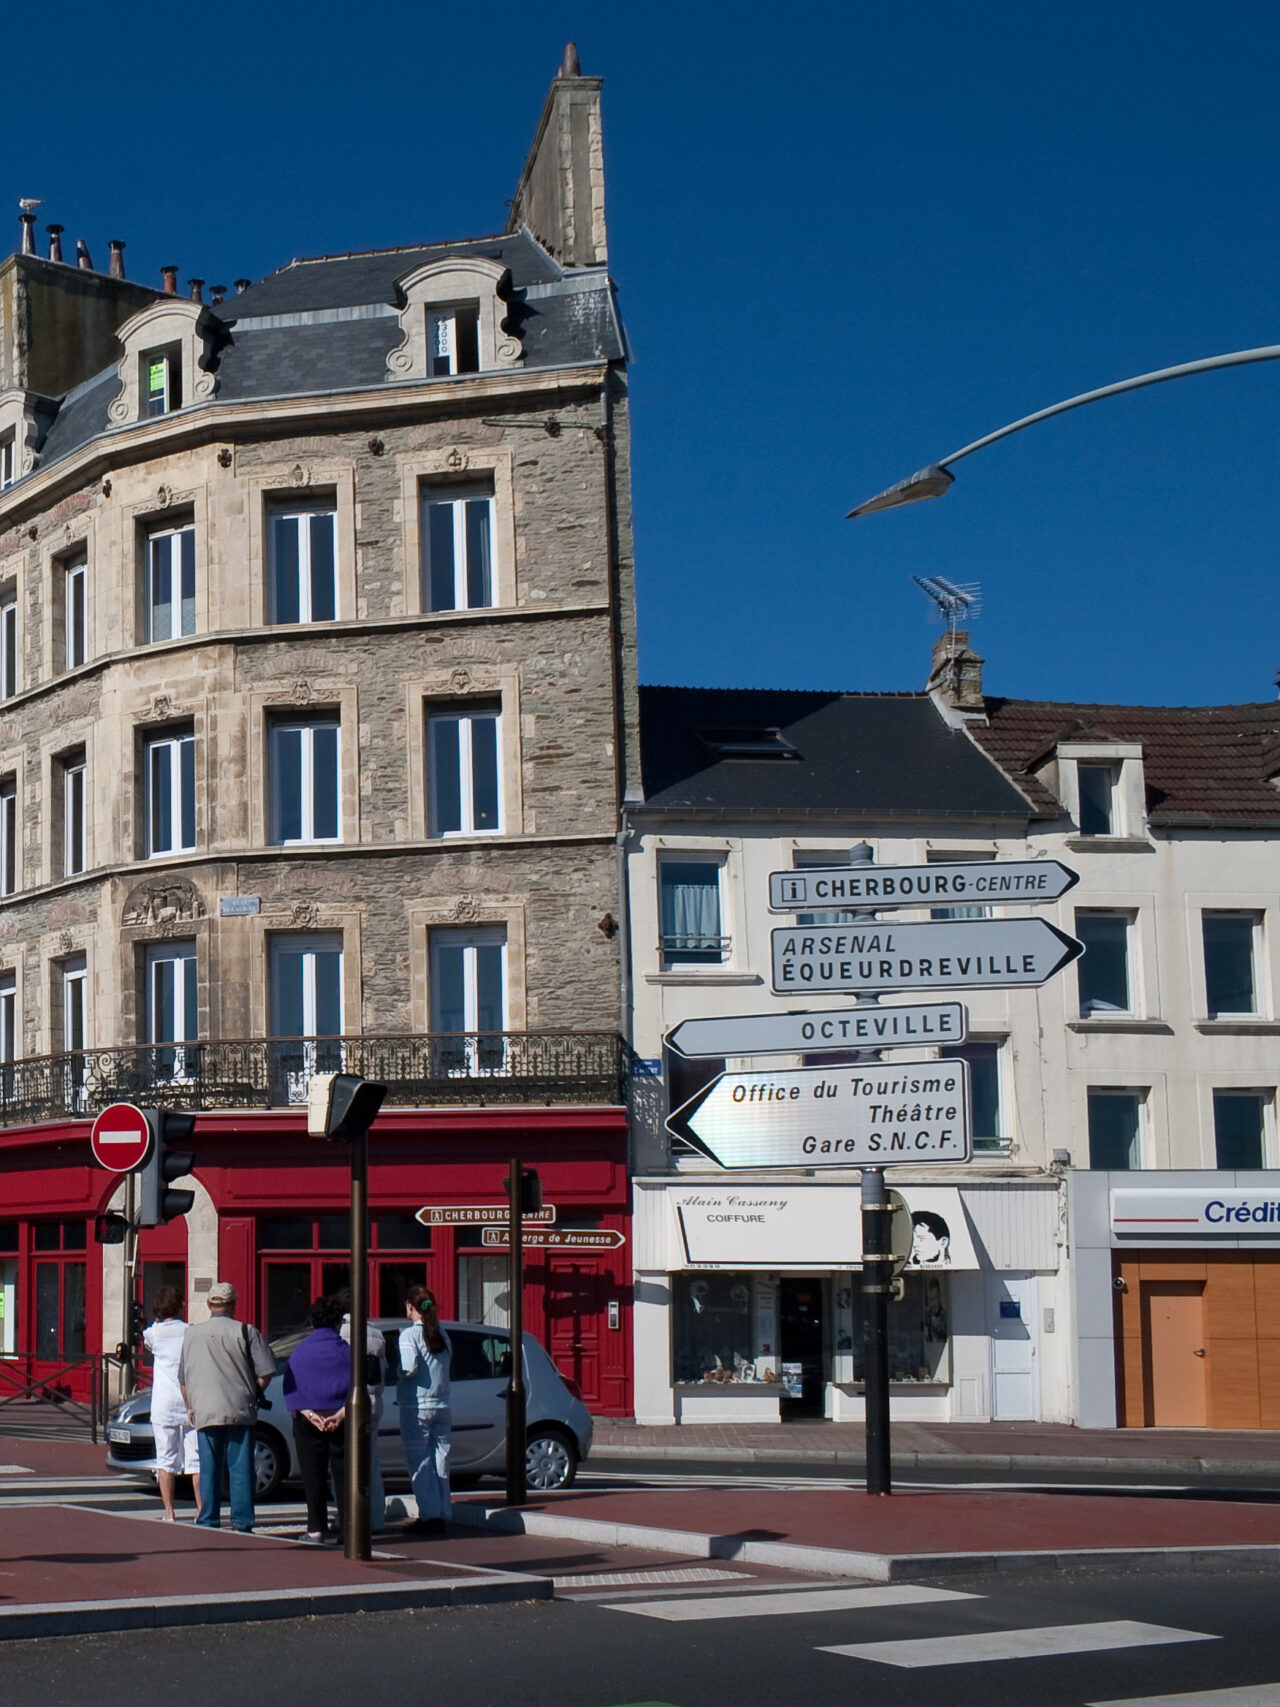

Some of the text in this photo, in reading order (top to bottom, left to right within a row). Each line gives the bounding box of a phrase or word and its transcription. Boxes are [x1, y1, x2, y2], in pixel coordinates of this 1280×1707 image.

[782, 934, 897, 956] ARSENAL
[782, 955, 1036, 982] ÉQUEURDREVILLE
[801, 1013, 953, 1040] OCTEVILLE
[732, 1075, 956, 1103] Office du Tourisme
[869, 1103, 957, 1124] Théâtre
[802, 1130, 958, 1155] Gare S.N.C.F.
[682, 1196, 722, 1207] Alain
[706, 1214, 766, 1223] COIFFURE
[502, 1232, 612, 1244] Aerge de Jeunesse
